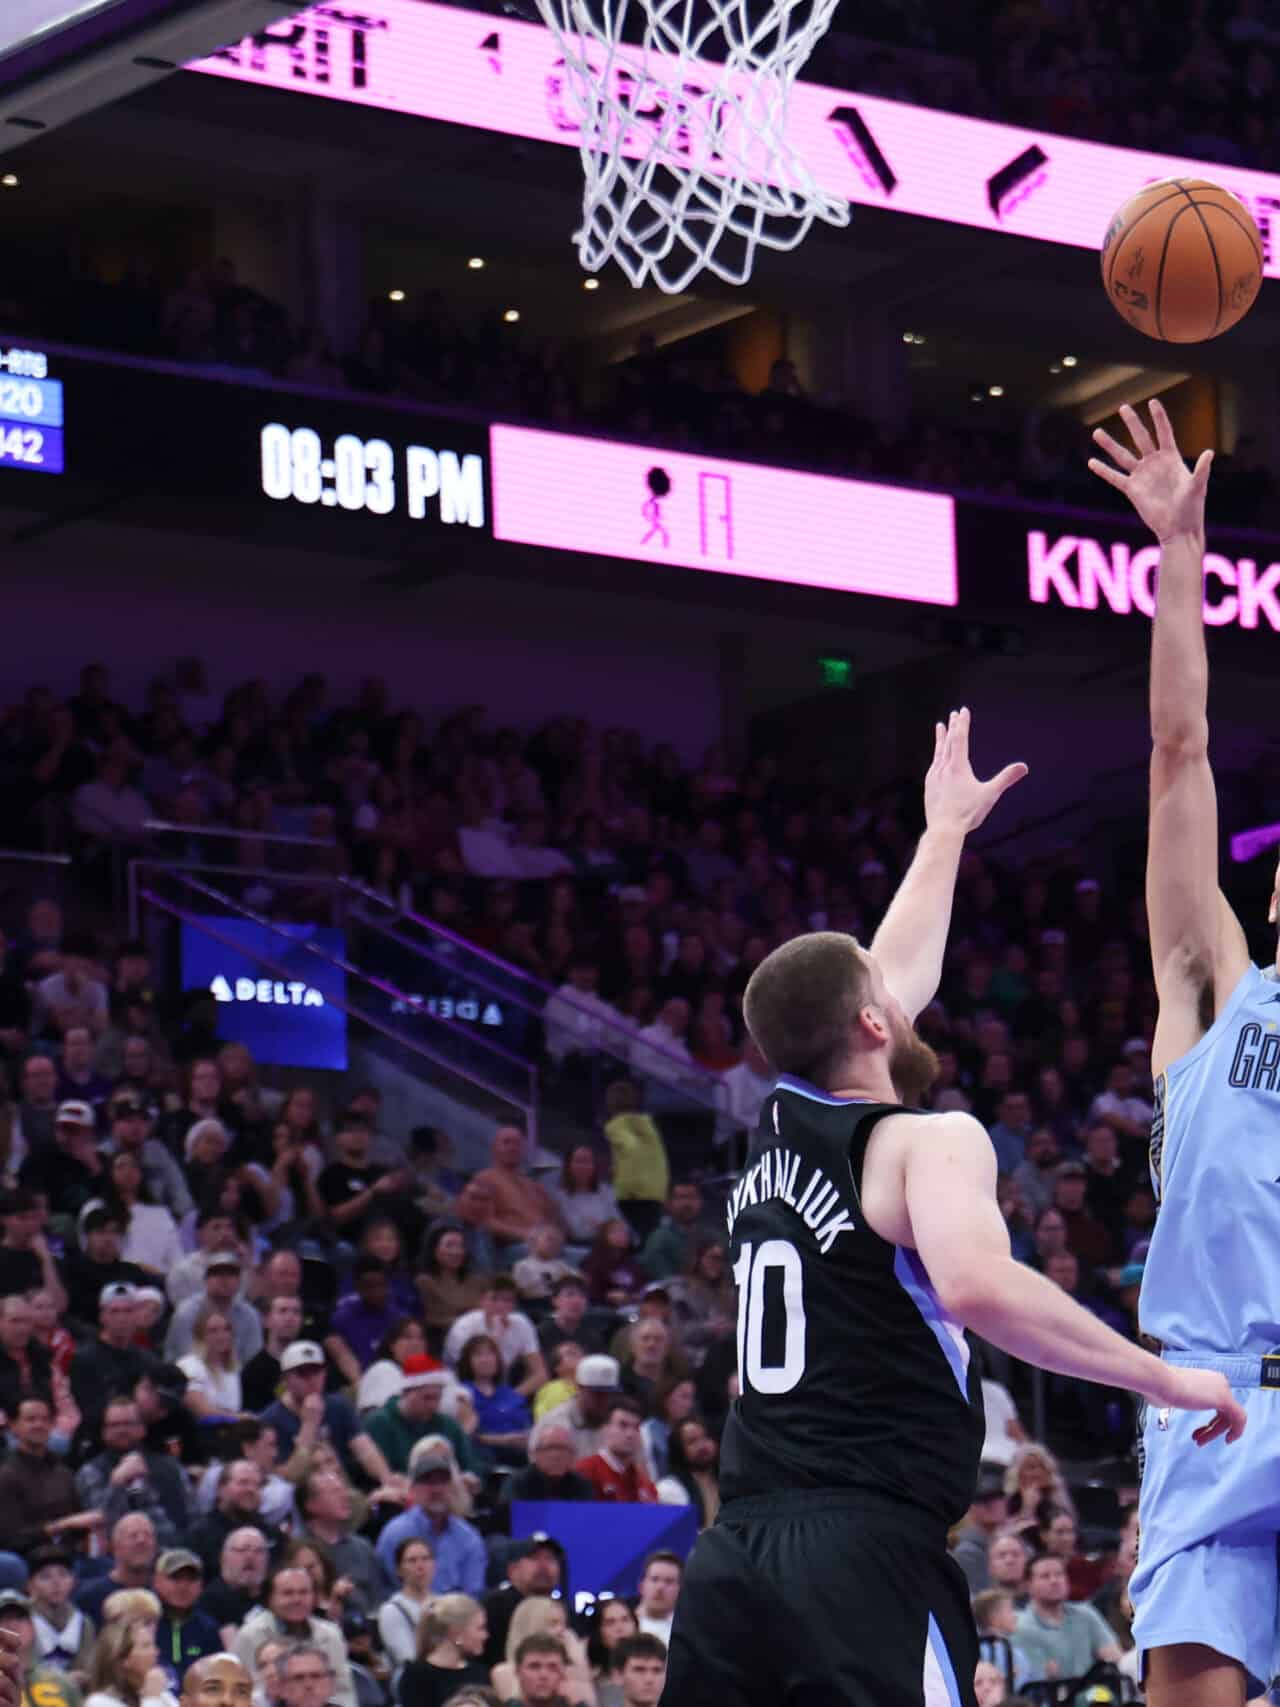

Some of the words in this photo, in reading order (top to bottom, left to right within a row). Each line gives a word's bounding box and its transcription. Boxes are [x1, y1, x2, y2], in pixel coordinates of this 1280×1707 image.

[208, 7, 388, 89] RIT
[260, 422, 396, 515] 08:03
[406, 445, 485, 528] PM
[235, 977, 325, 1008] DELTA
[732, 1238, 807, 1397] 10
